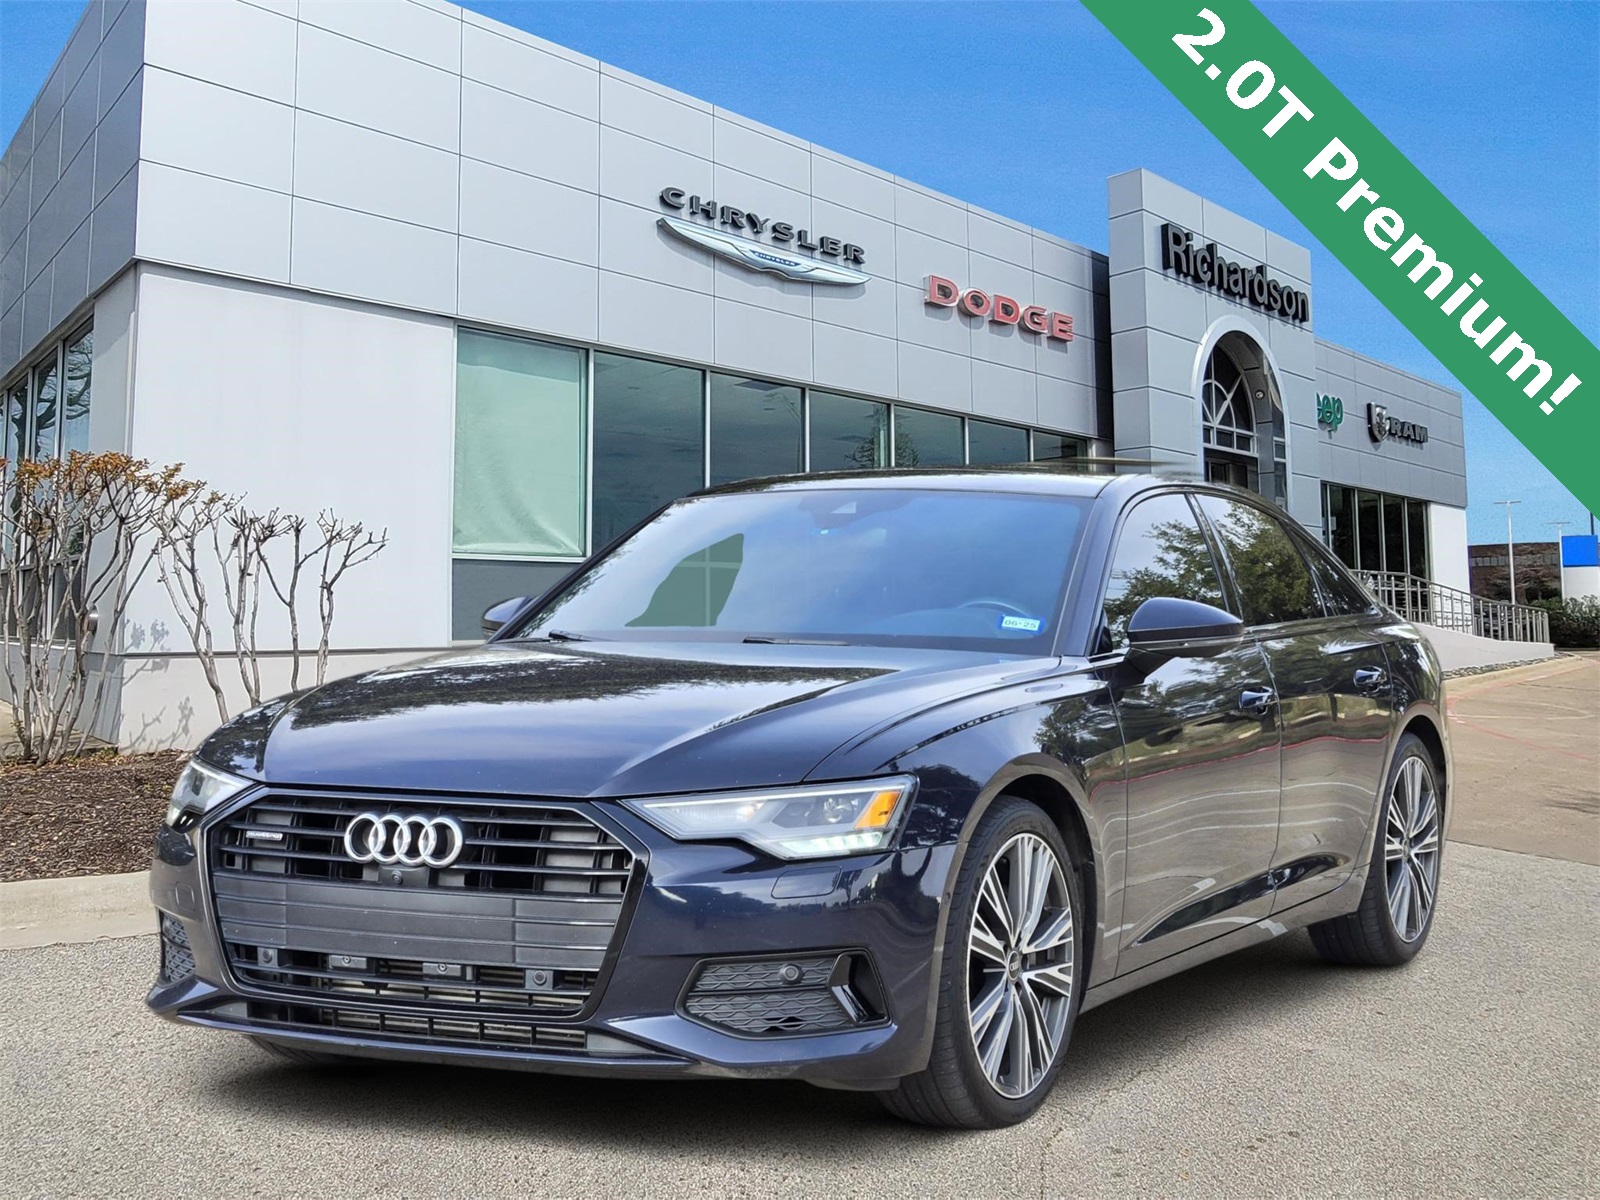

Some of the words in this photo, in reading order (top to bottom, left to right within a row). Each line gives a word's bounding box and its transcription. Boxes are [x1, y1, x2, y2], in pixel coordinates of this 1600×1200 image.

[659, 187, 866, 265] CHRYSLER
[924, 275, 1074, 343] DODGE
[1161, 223, 1310, 324] Richardson
[1387, 417, 1429, 444] RAM
